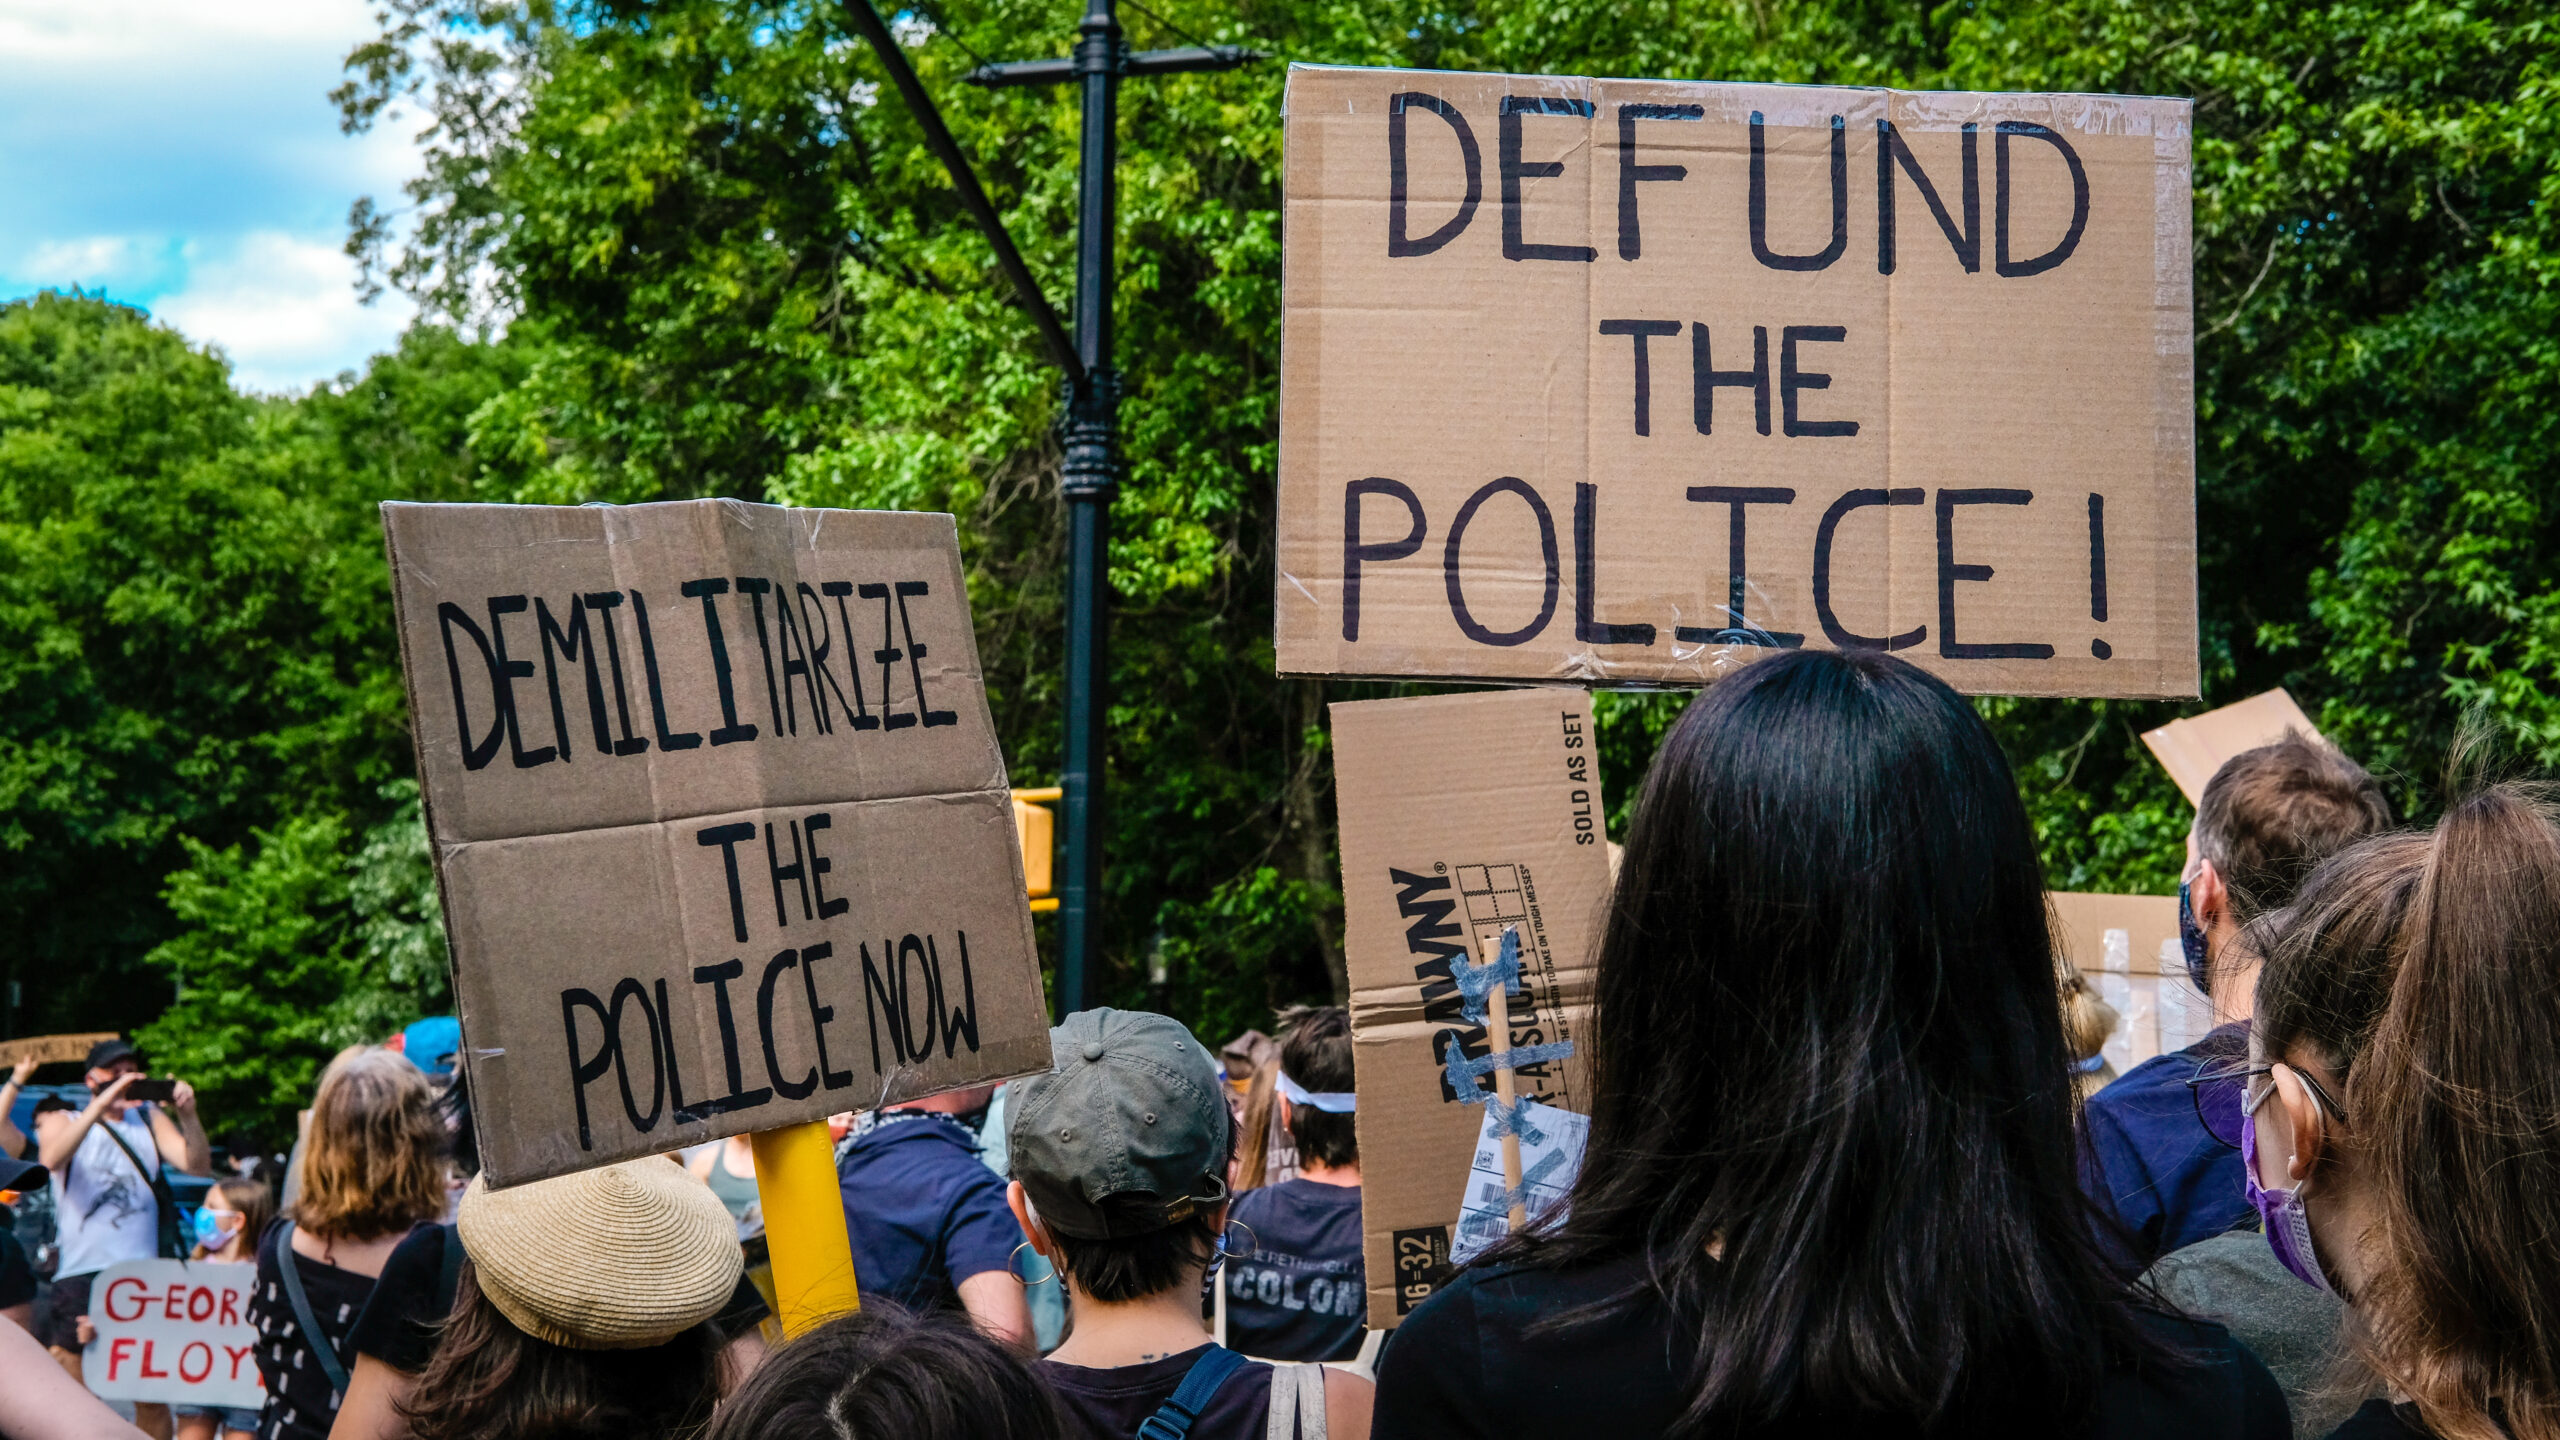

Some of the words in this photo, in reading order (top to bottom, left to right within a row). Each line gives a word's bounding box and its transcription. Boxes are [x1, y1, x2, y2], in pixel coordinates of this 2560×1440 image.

[1389, 91, 2091, 277] DEFUND
[1600, 319, 1861, 438] THE
[1342, 476, 2113, 660] POLICE!
[437, 576, 958, 772] DEMILITARIZE
[1561, 711, 1583, 749] SET
[1566, 755, 1588, 783] AS
[1570, 789, 1595, 846] SOLD
[696, 812, 850, 944] THE
[1529, 904, 1545, 934] TOUGH
[1537, 935, 1549, 948] ON
[1541, 949, 1555, 972] TAKE
[1547, 971, 1558, 984] TO
[561, 940, 854, 1152] POLICE
[859, 929, 981, 1077] NOW
[105, 1277, 239, 1326] GEOR
[107, 1338, 266, 1389] FLOY
